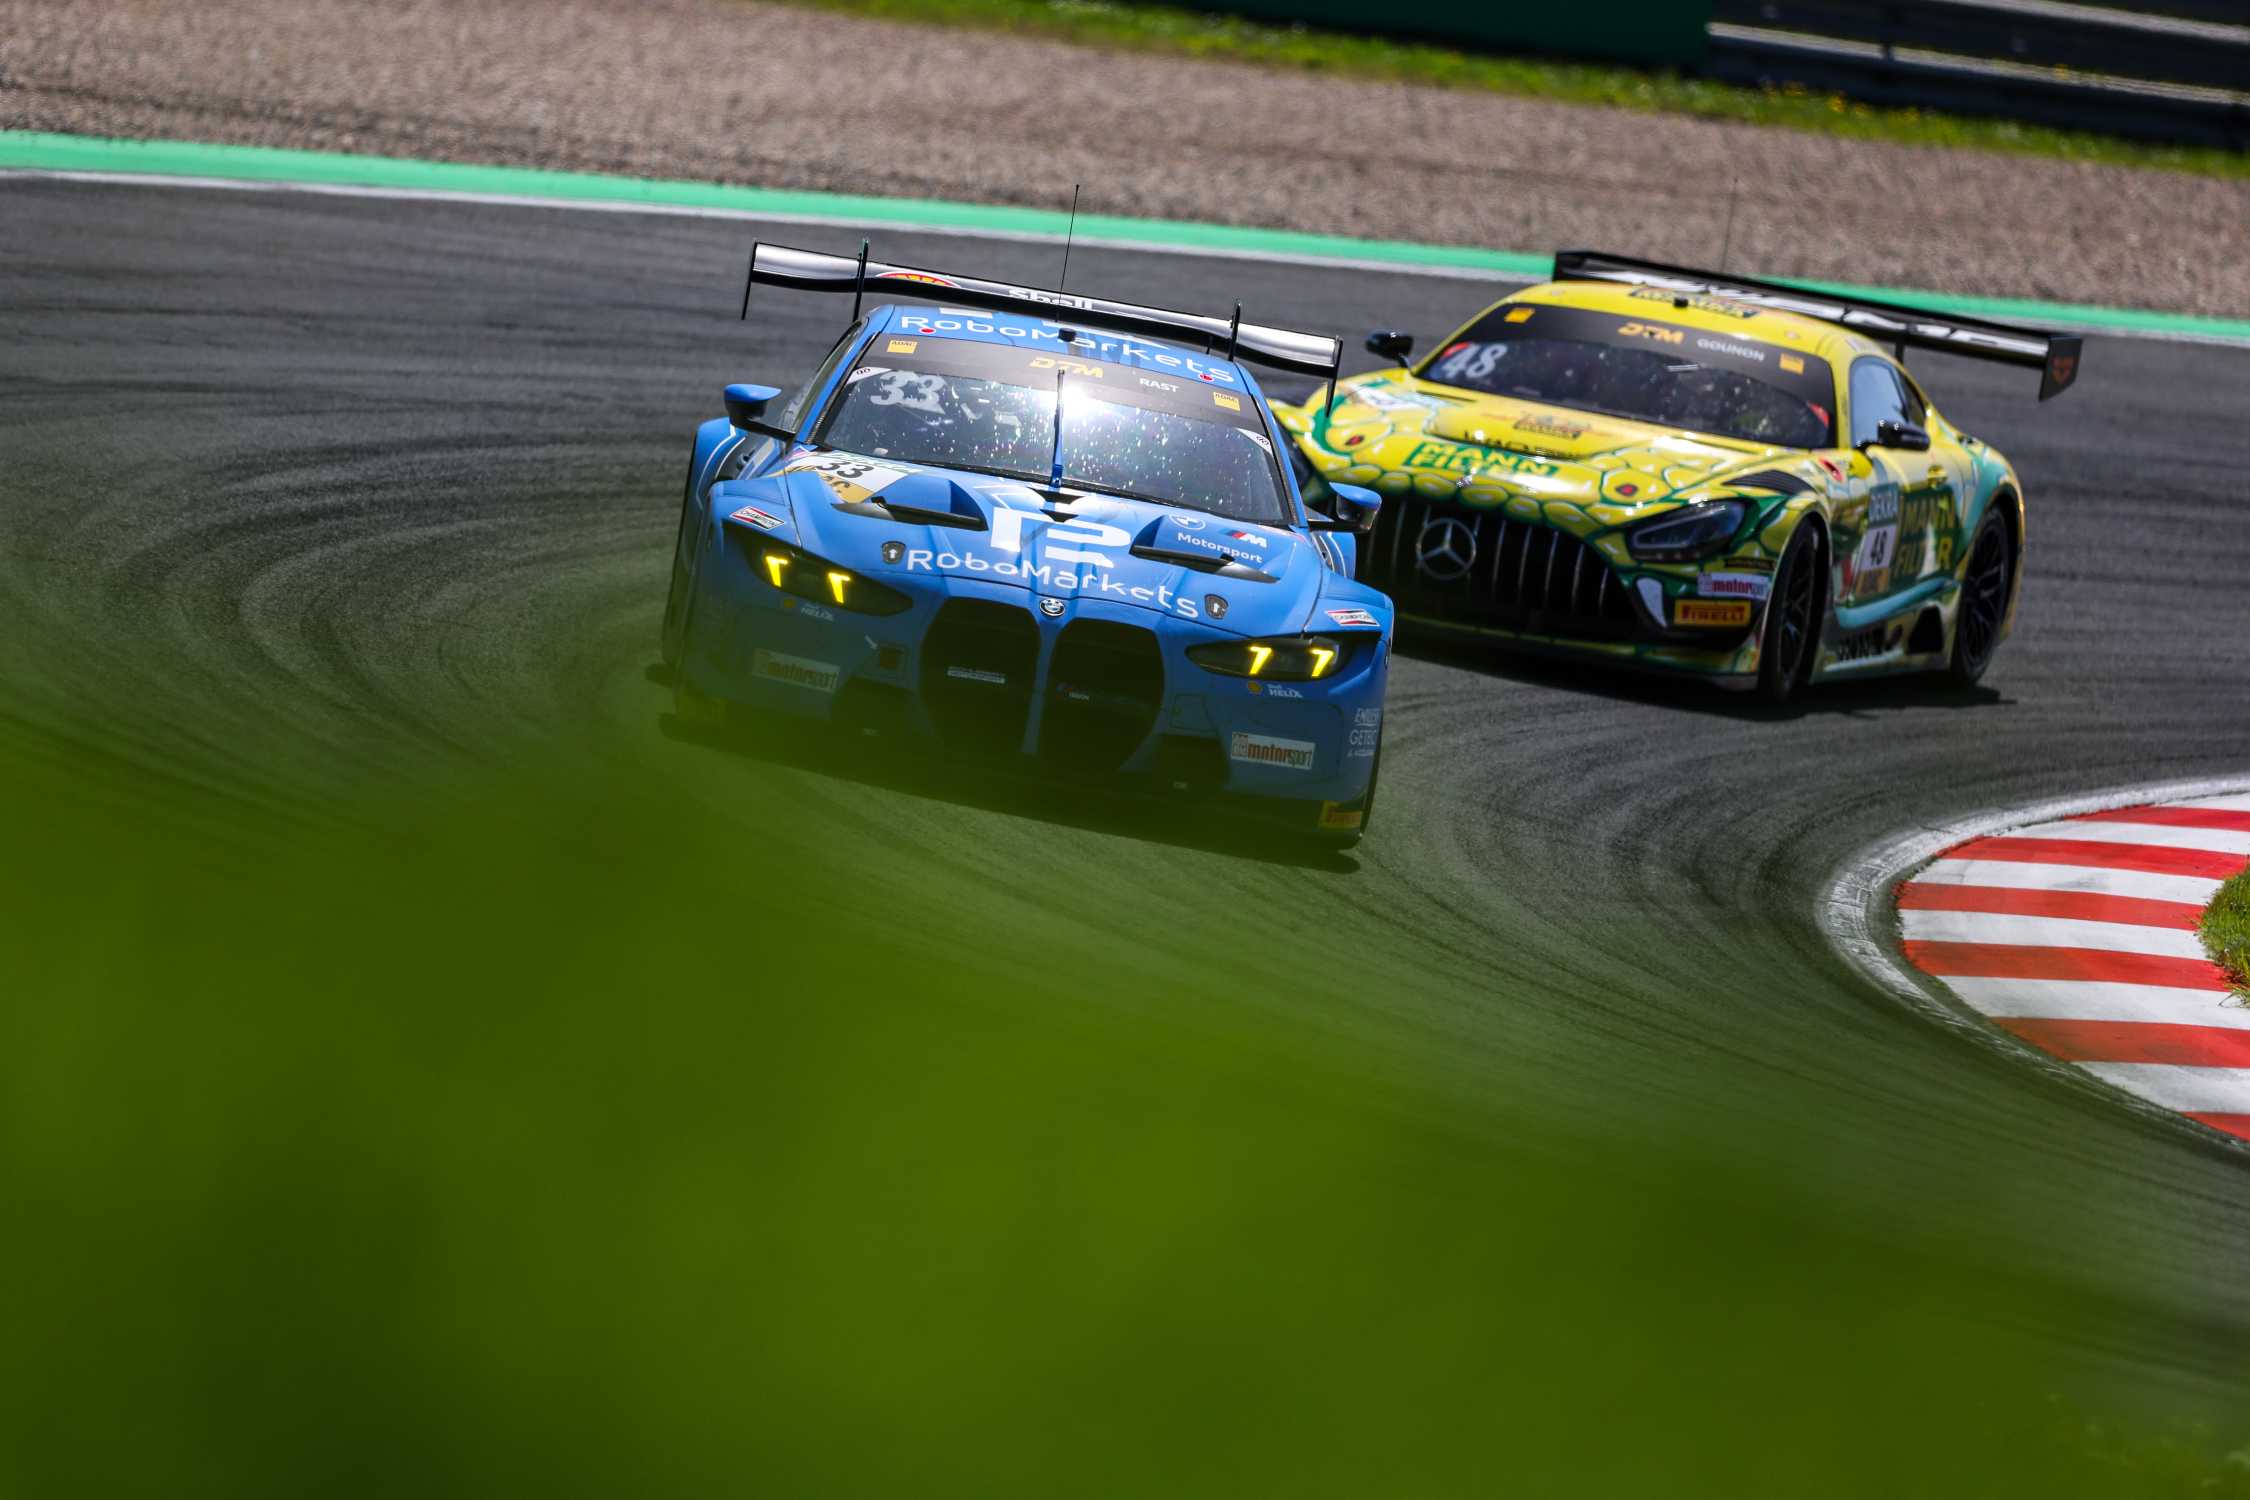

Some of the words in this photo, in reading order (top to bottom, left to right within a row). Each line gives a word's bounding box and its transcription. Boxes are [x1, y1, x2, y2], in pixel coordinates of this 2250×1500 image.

[1617, 321, 1685, 345] DTM
[901, 315, 1234, 383] RoboMarkets
[1441, 342, 1508, 379] 48
[1697, 337, 1766, 362] GOUNON
[1029, 356, 1105, 380] DTM
[1139, 377, 1180, 393] RAST
[815, 461, 875, 479] 33
[1177, 532, 1264, 564] Motorsport
[906, 548, 1200, 618] RoboMarkets
